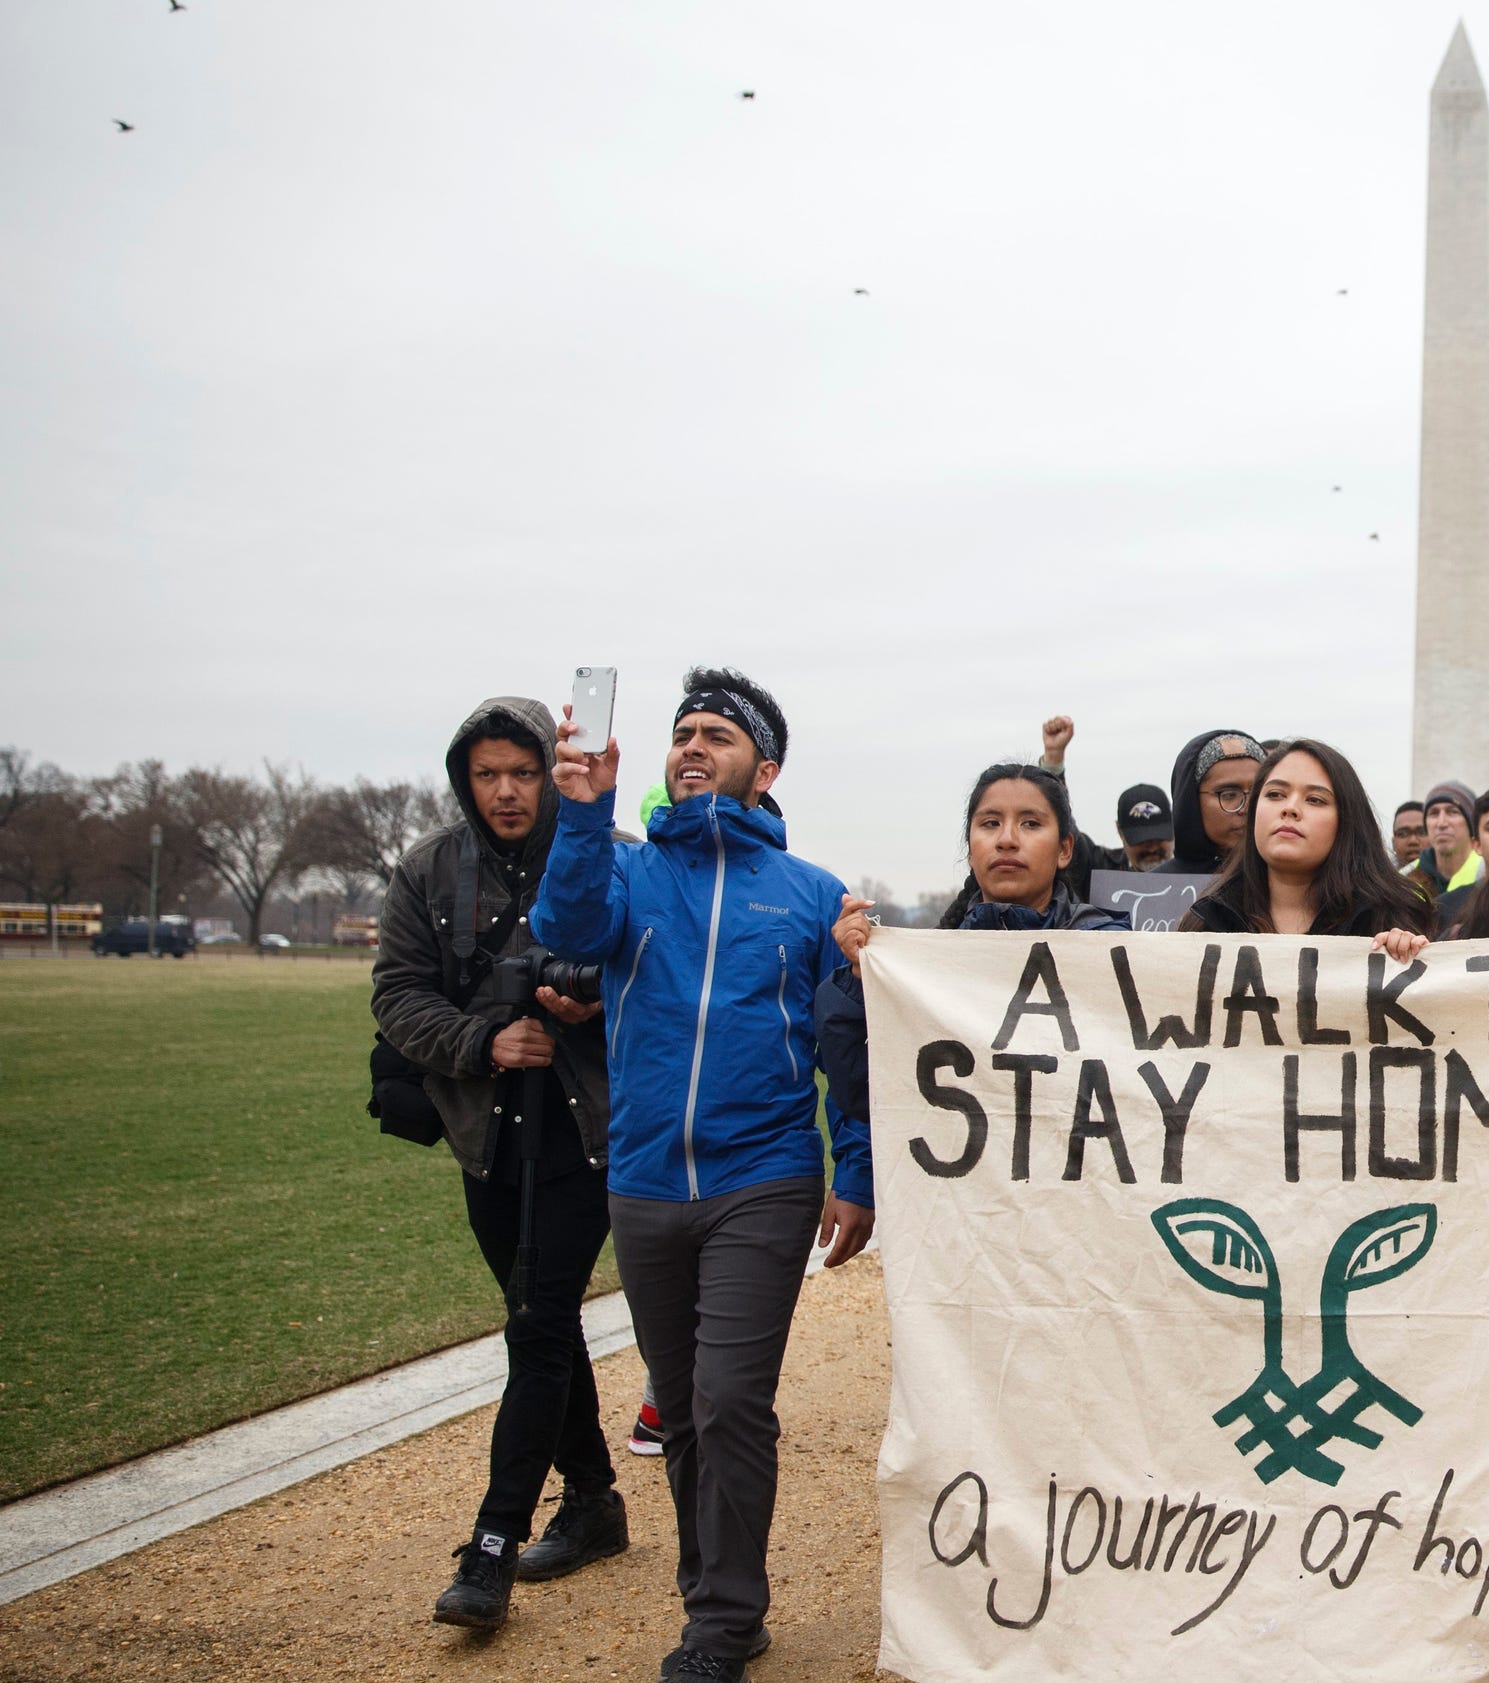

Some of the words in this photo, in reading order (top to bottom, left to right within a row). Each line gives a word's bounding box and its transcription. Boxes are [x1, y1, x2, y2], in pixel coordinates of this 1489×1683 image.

[748, 902, 790, 915] Marmot
[989, 941, 1080, 1051] A
[1110, 943, 1437, 1050] WALK
[907, 1039, 1212, 1185] STAY
[927, 1470, 991, 1568] a
[986, 1472, 1278, 1637] journey
[1301, 1489, 1404, 1590] of
